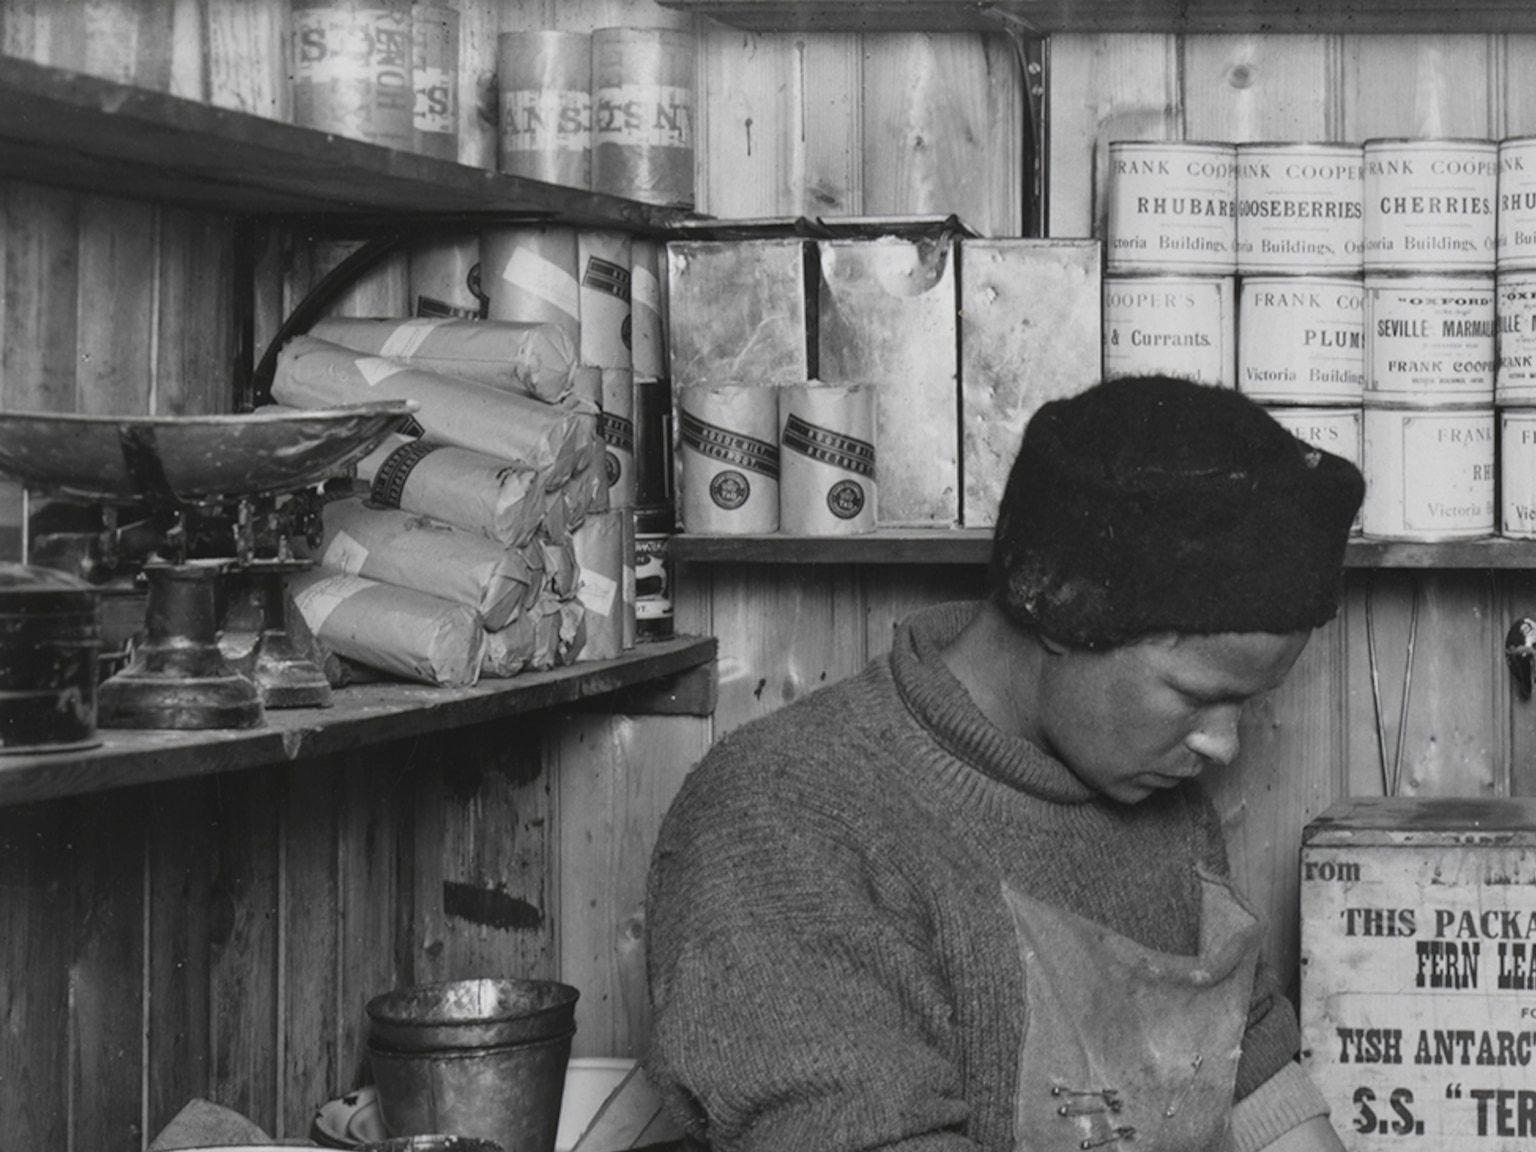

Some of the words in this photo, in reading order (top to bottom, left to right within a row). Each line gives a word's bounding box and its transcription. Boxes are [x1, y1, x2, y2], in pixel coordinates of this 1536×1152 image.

[1380, 196, 1493, 216] CHERRIES.
[1254, 293, 1321, 309] FRANK
[1377, 319, 1430, 338] SEVILLE
[1131, 329, 1212, 347] Currants.
[1246, 366, 1297, 382] Victoria
[1387, 360, 1443, 373] FRANK
[1427, 504, 1481, 519] Victoria
[1340, 907, 1417, 938] THIS
[1415, 940, 1481, 990] FERN
[1352, 1086, 1425, 1136] S.S.
